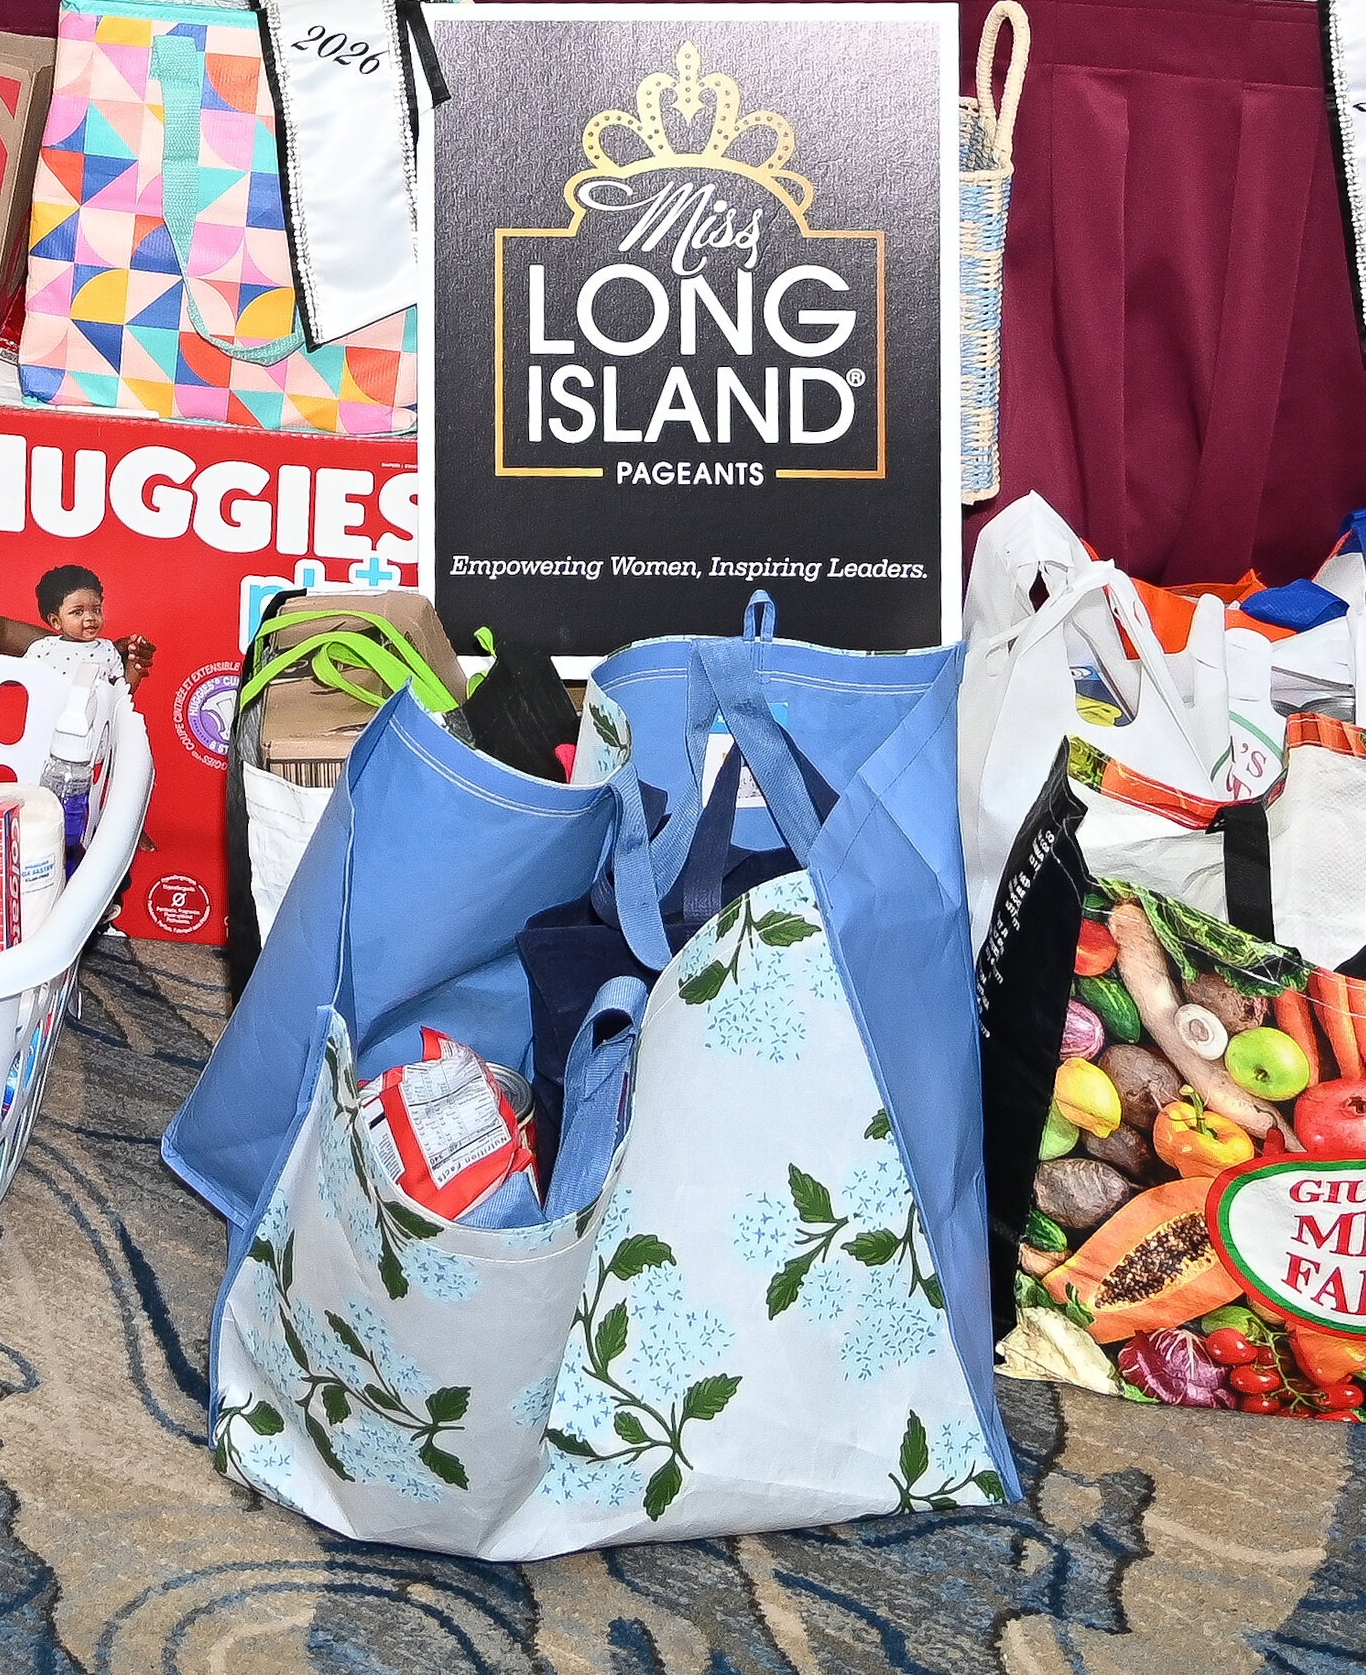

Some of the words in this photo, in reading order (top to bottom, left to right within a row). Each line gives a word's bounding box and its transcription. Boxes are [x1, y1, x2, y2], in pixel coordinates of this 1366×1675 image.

[291, 25, 389, 74] 2026
[579, 180, 763, 277] Miss
[529, 263, 857, 358] LONG
[617, 462, 764, 485] PAGEANTS
[451, 556, 603, 580] Empowering
[610, 557, 702, 577] Women,
[710, 557, 821, 581] Inspiring
[828, 557, 928, 578] Leaders.
[465, 1136, 508, 1165] Nutrition
[438, 1162, 462, 1182] Facts
